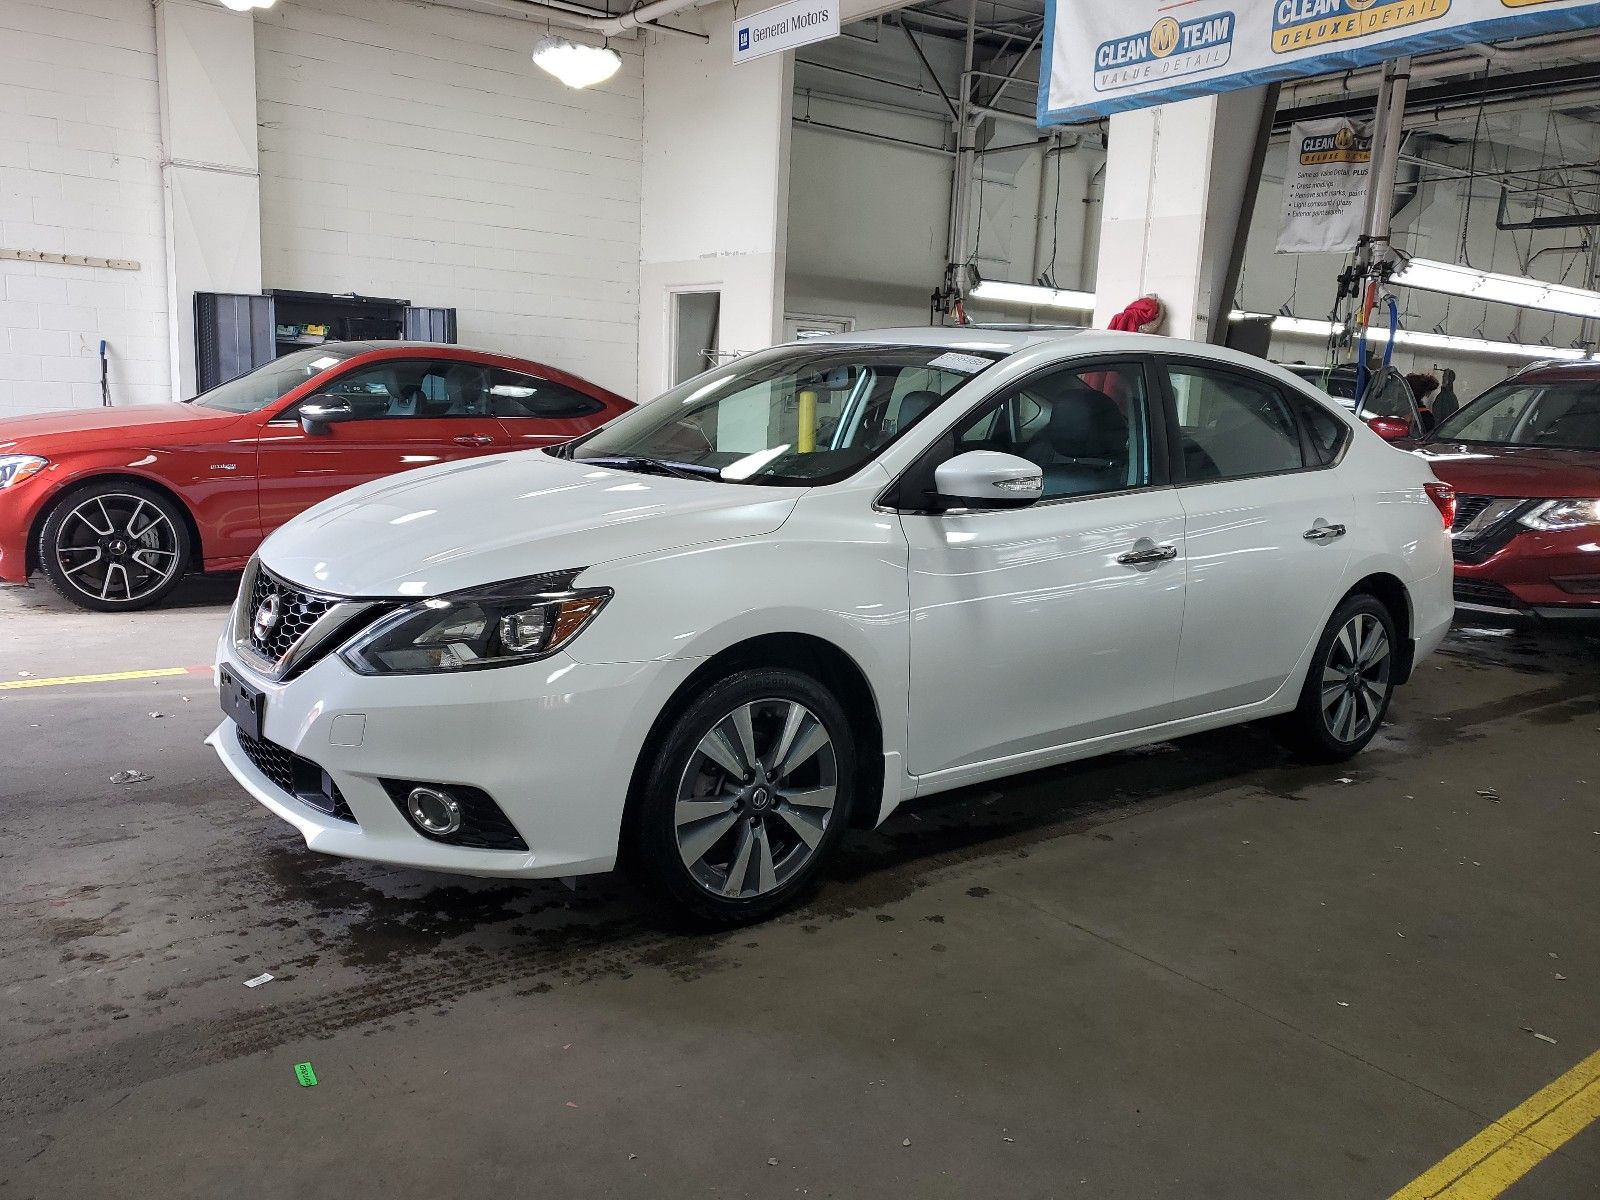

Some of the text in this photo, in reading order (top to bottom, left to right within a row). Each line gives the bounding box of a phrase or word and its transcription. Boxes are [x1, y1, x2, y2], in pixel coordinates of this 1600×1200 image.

[753, 9, 829, 43] General Motors
[1281, 0, 1437, 46] DELUXE DETAIL
[1098, 36, 1148, 67] CLEAN
[1181, 16, 1230, 49] TEAM
[1101, 51, 1220, 86] VALUE DETAIL
[1303, 136, 1335, 152] CLEAN
[1352, 168, 1369, 176] PLUS
